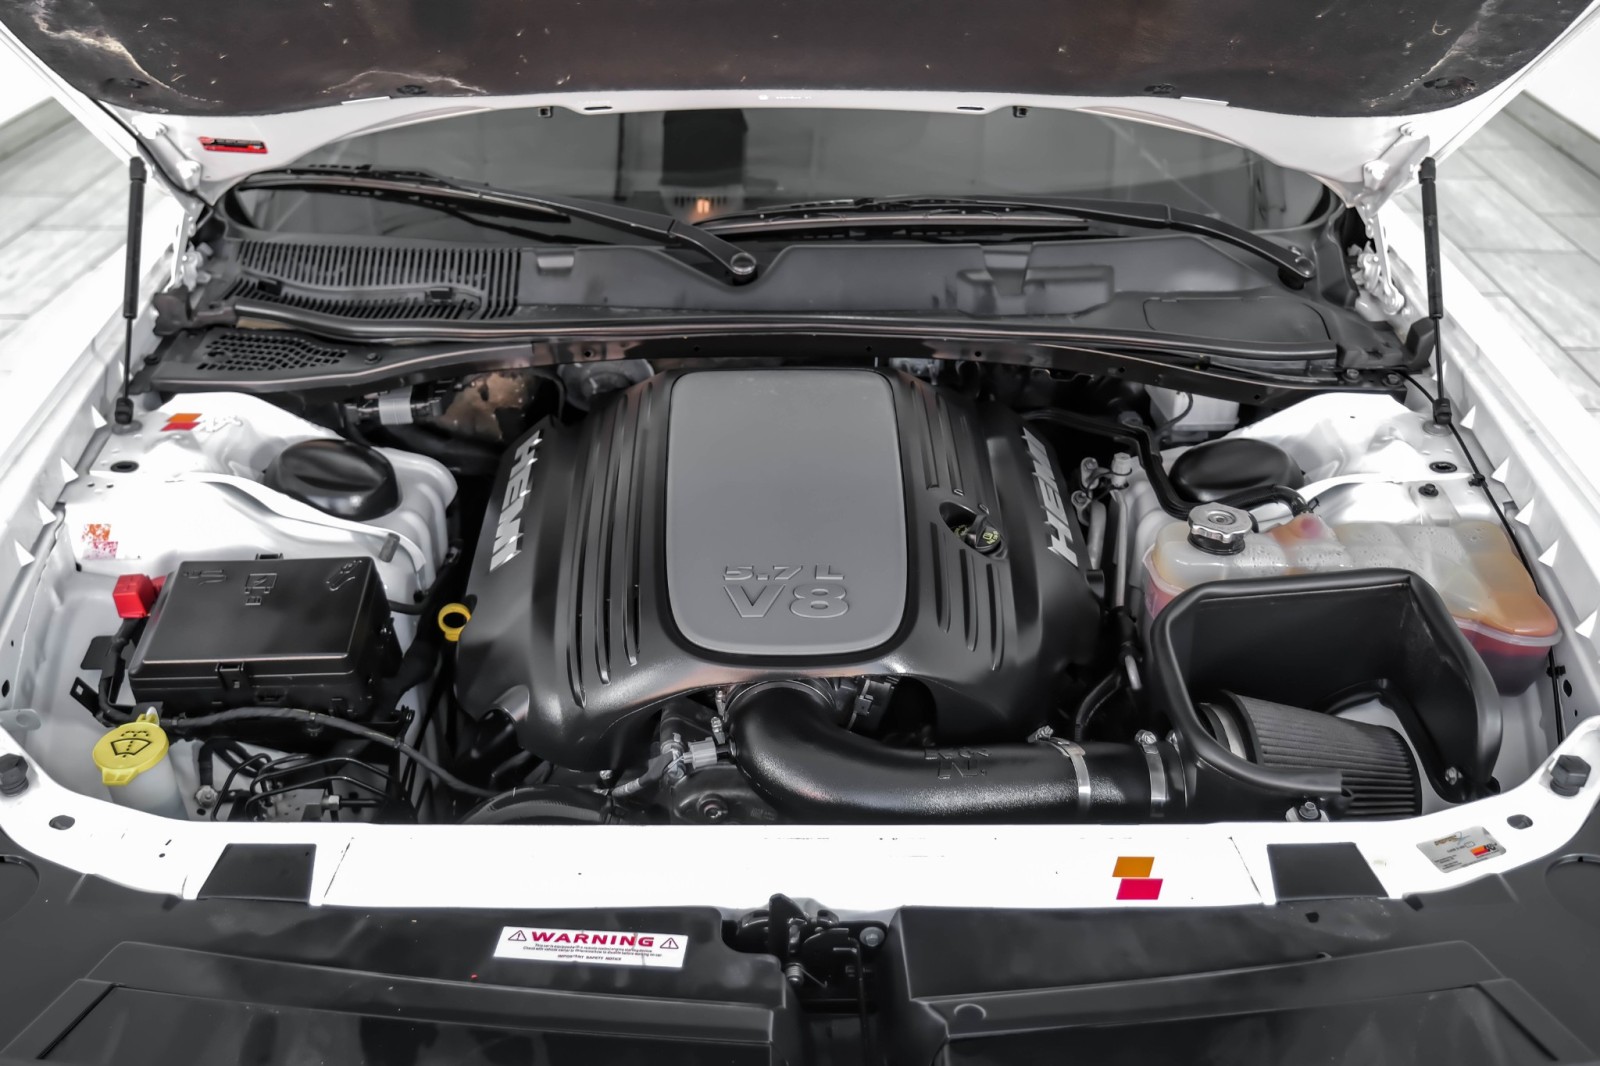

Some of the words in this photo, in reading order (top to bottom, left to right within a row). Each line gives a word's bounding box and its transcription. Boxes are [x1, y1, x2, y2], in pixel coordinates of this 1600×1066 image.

[489, 429, 543, 571] HEMI
[1021, 426, 1079, 567] HEMI
[723, 583, 849, 619] V8
[531, 931, 655, 948] WARNING
